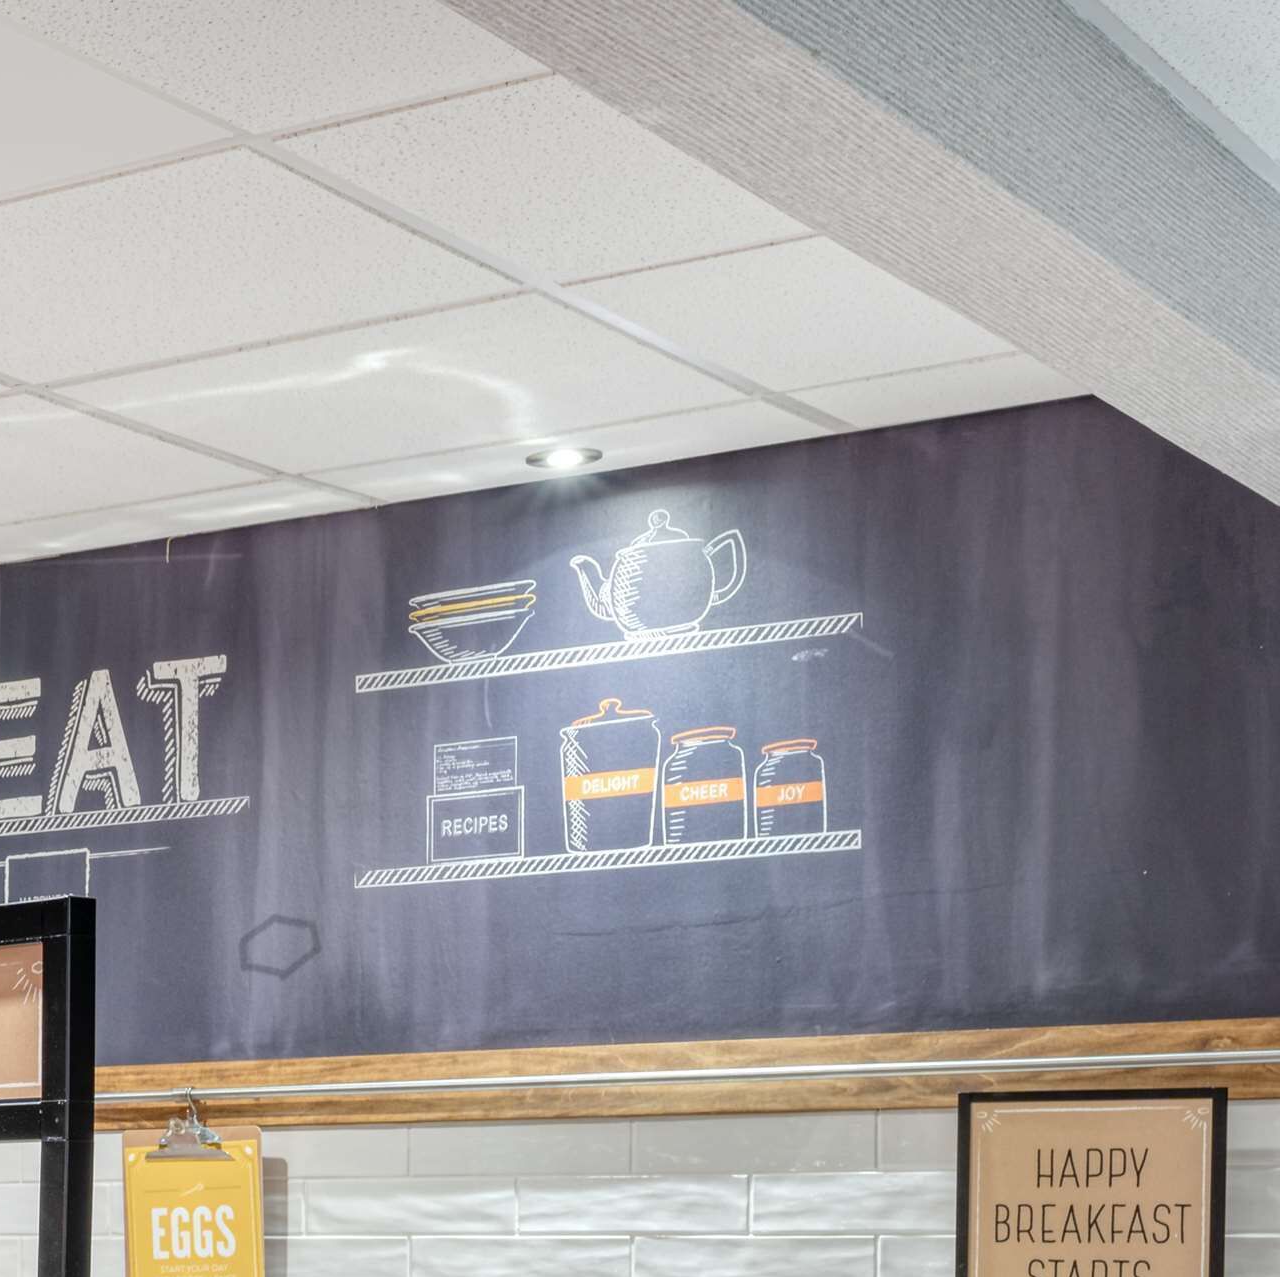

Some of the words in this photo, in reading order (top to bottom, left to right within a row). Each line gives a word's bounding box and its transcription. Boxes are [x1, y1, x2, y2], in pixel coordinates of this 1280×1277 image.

[581, 774, 640, 796] DELIGHT
[679, 782, 729, 802] CHEER
[776, 785, 806, 802] JOY
[441, 814, 509, 839] RECIPES
[1036, 1147, 1149, 1188] HAPPY
[151, 1204, 236, 1260] EGGS
[994, 1203, 1193, 1245] BREAKFAST
